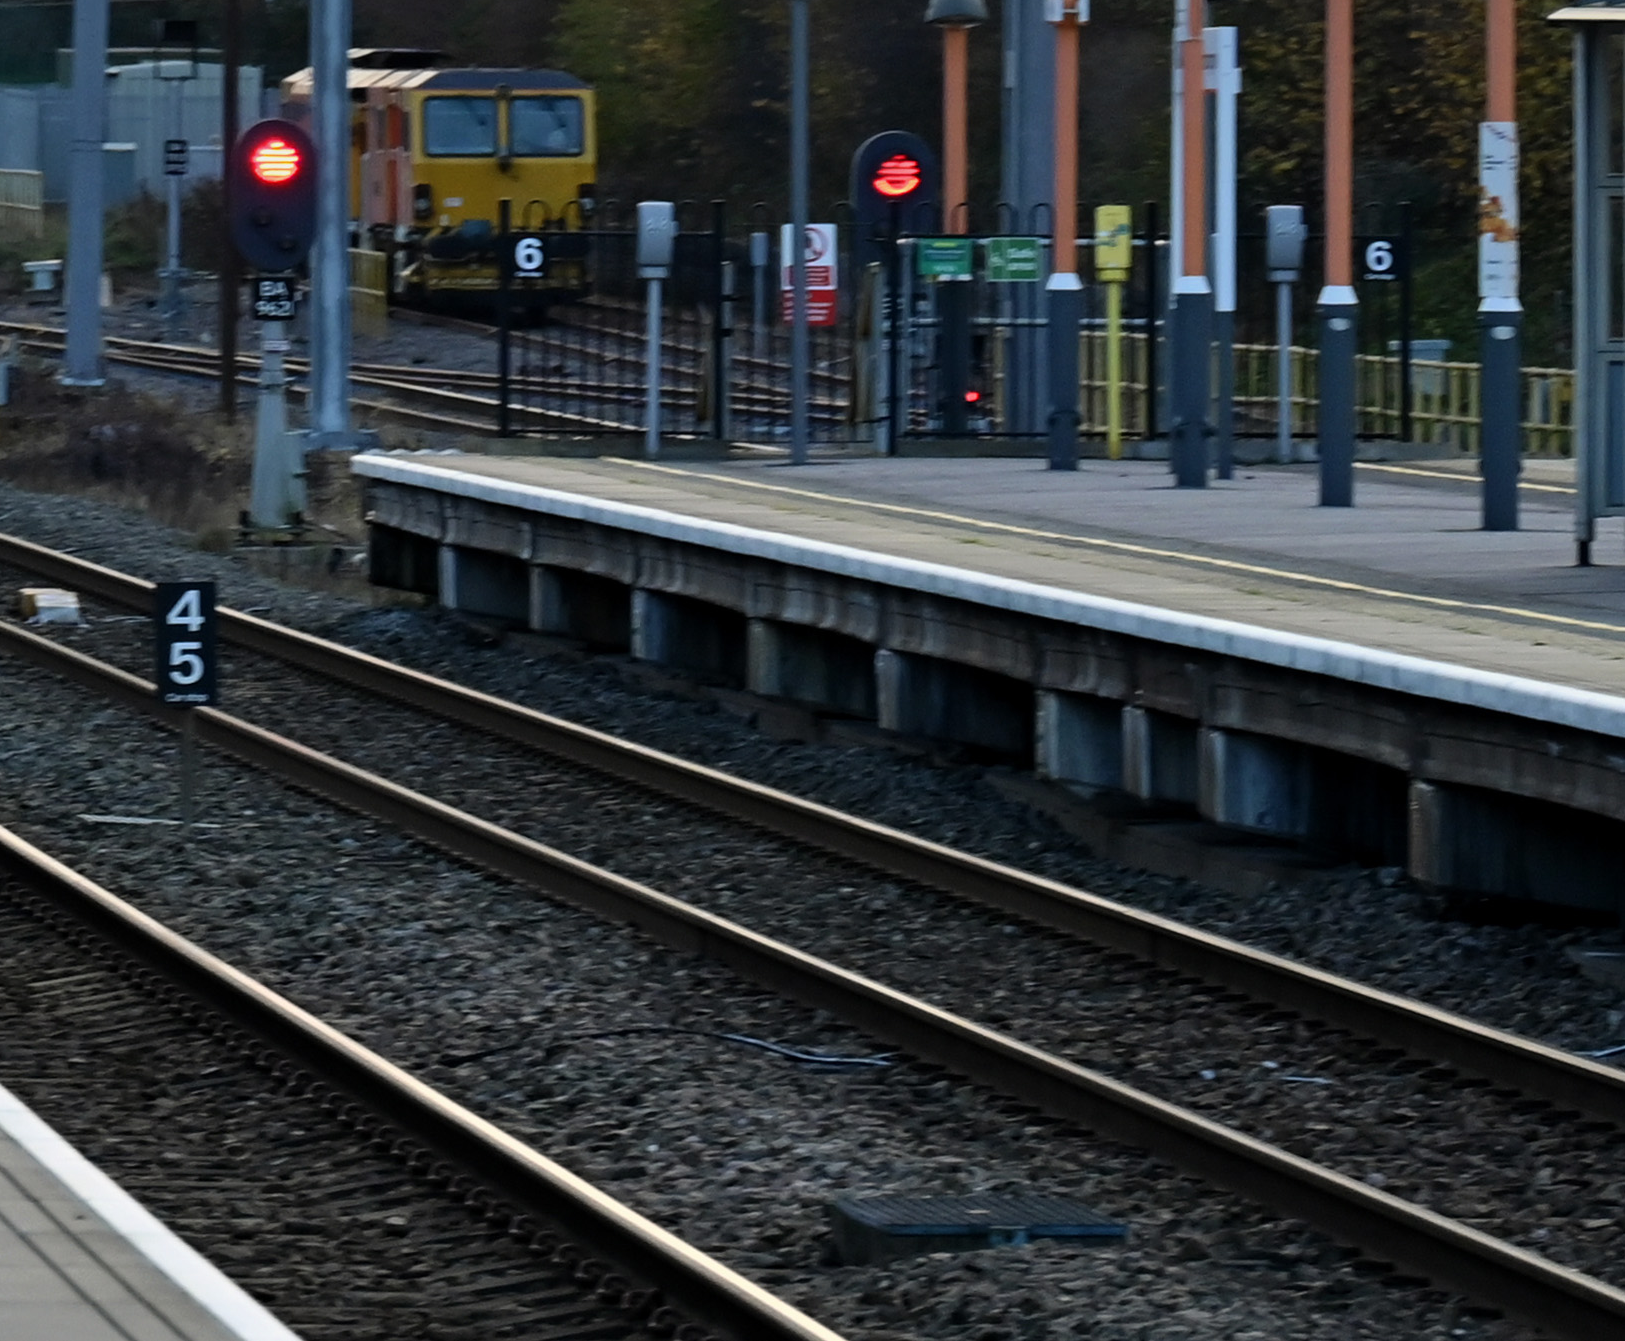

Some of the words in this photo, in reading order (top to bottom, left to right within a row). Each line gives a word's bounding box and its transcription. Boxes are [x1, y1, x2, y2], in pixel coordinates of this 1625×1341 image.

[514, 237, 544, 270] 6
[1365, 241, 1393, 272] 6
[165, 589, 206, 632] 4
[169, 641, 204, 685] 5
